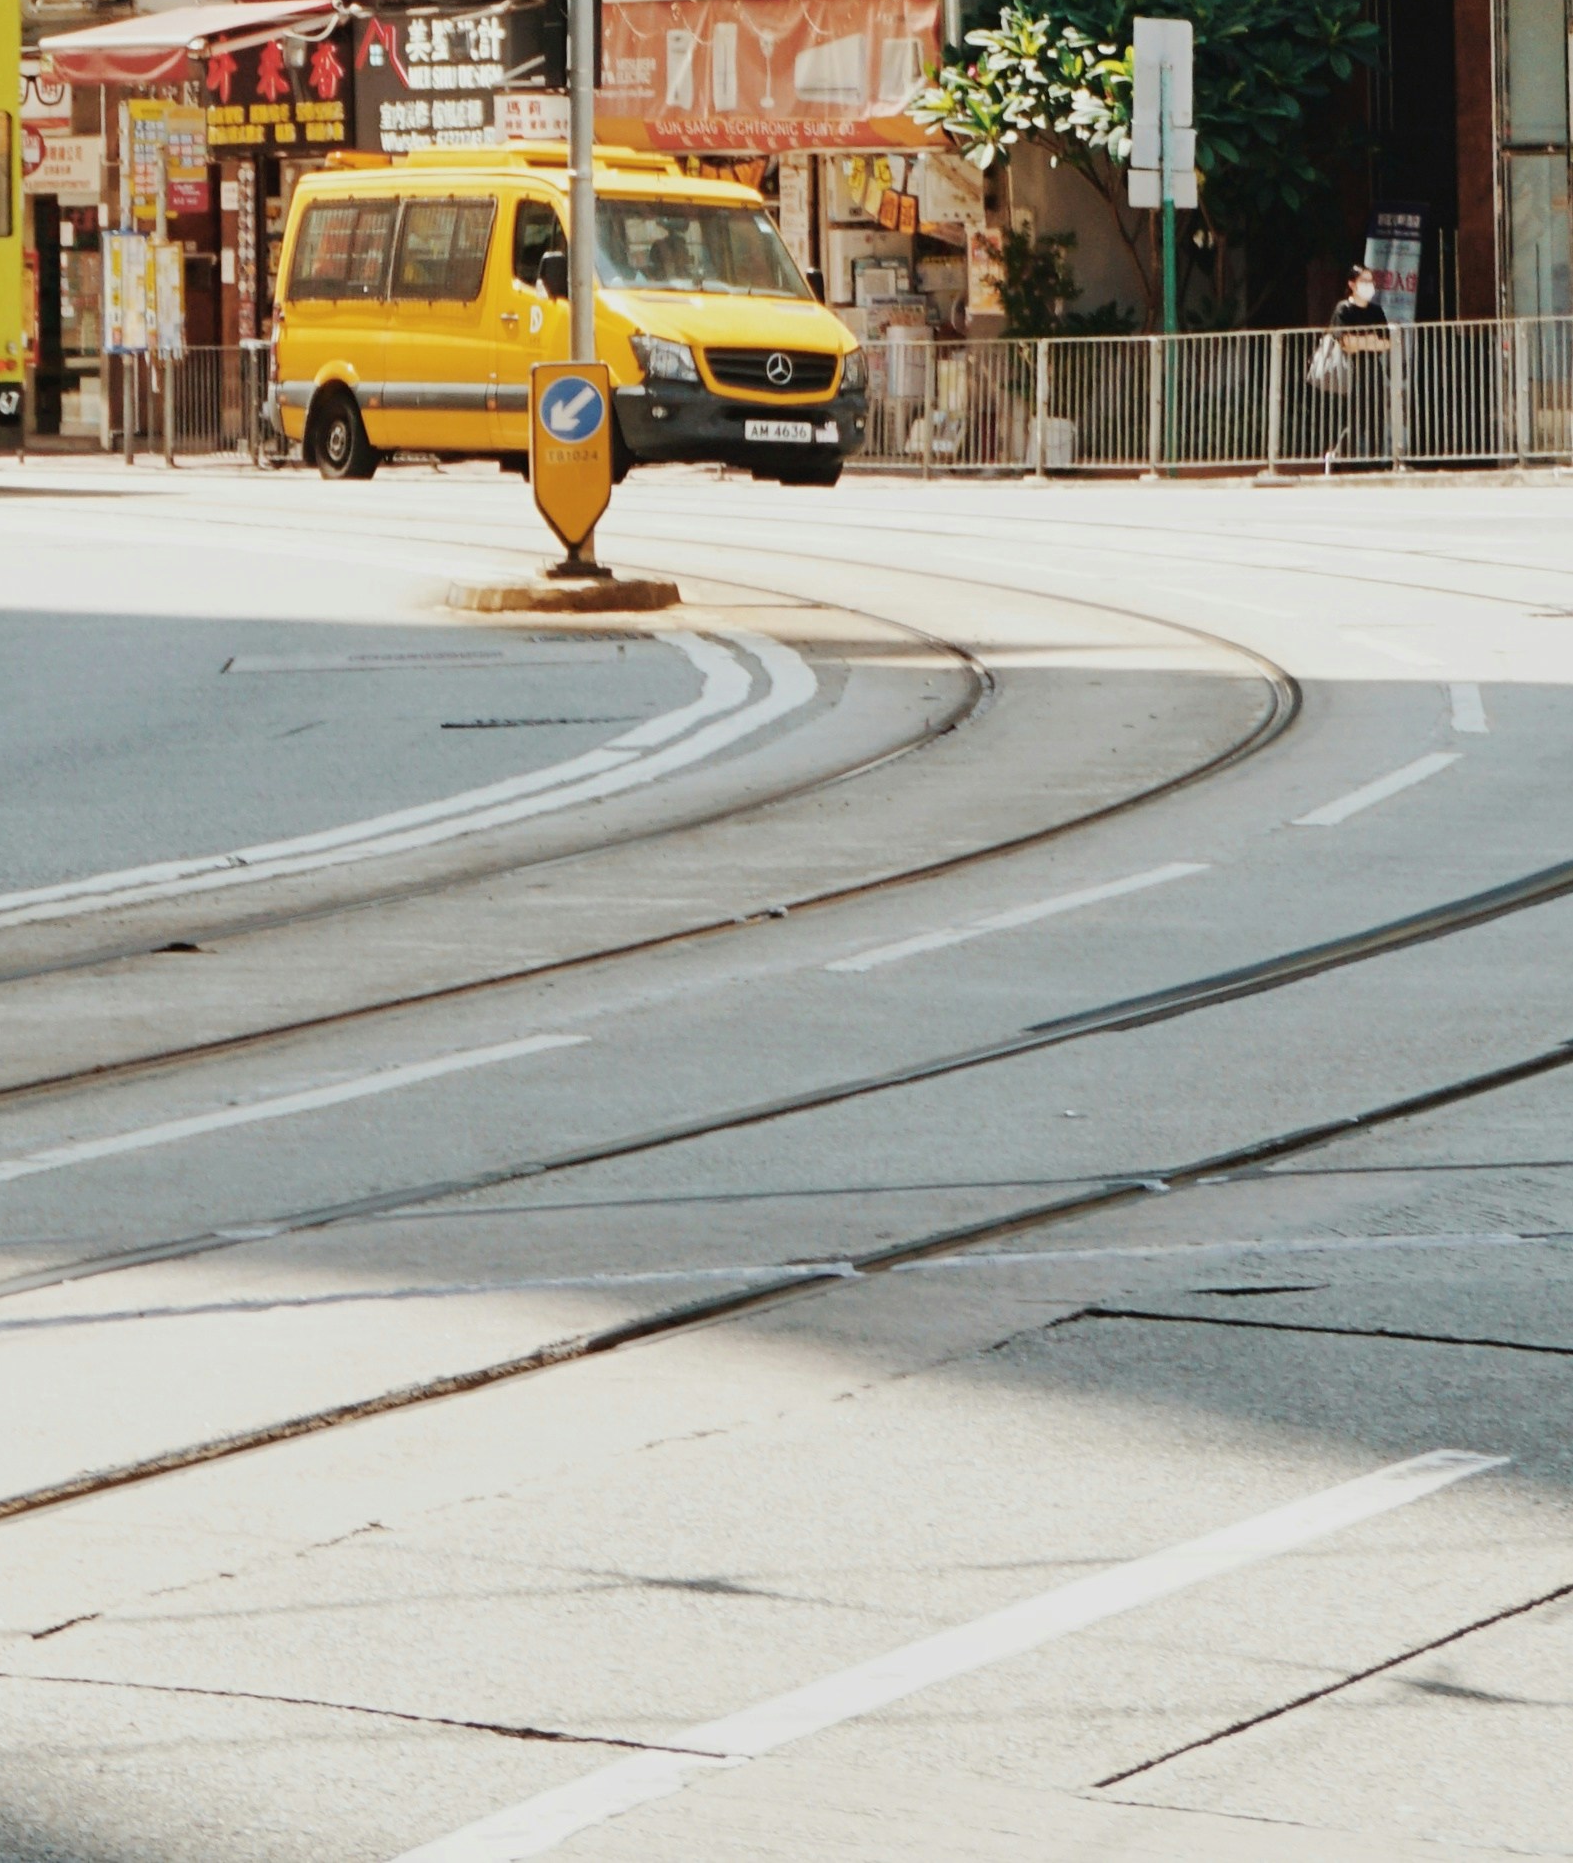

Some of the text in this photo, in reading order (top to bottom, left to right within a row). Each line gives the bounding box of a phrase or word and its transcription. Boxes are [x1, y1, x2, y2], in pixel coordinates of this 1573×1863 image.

[656, 121, 682, 136] SUN
[685, 121, 718, 136] SANG
[750, 425, 807, 439] AM 4636
